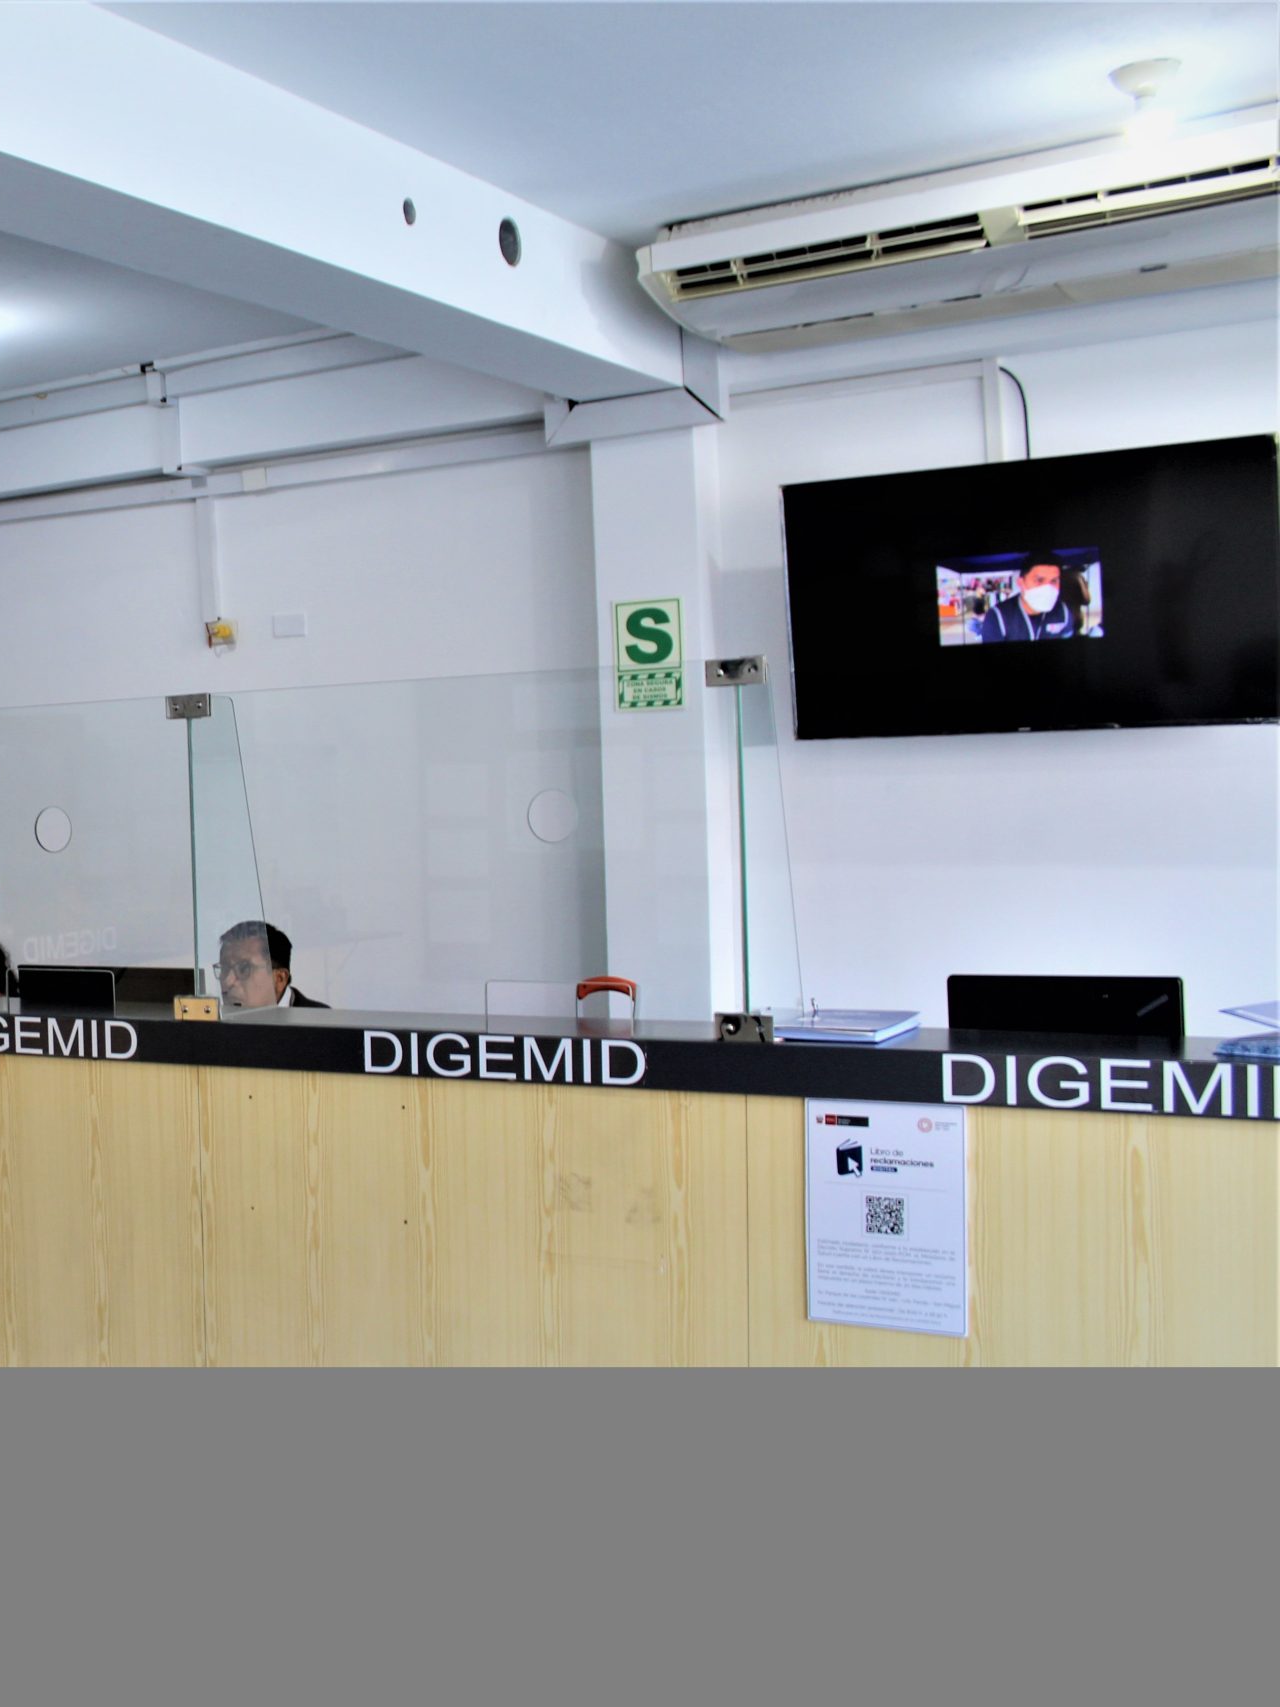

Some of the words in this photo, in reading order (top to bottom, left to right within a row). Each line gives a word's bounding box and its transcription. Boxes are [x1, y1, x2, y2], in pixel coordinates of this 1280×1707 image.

[625, 608, 673, 664] S
[363, 1030, 646, 1086] DIGEMID
[942, 1053, 1280, 1119] DIGEMI
[870, 1148, 890, 1156] Libro
[870, 1158, 934, 1168] reclamaciones
